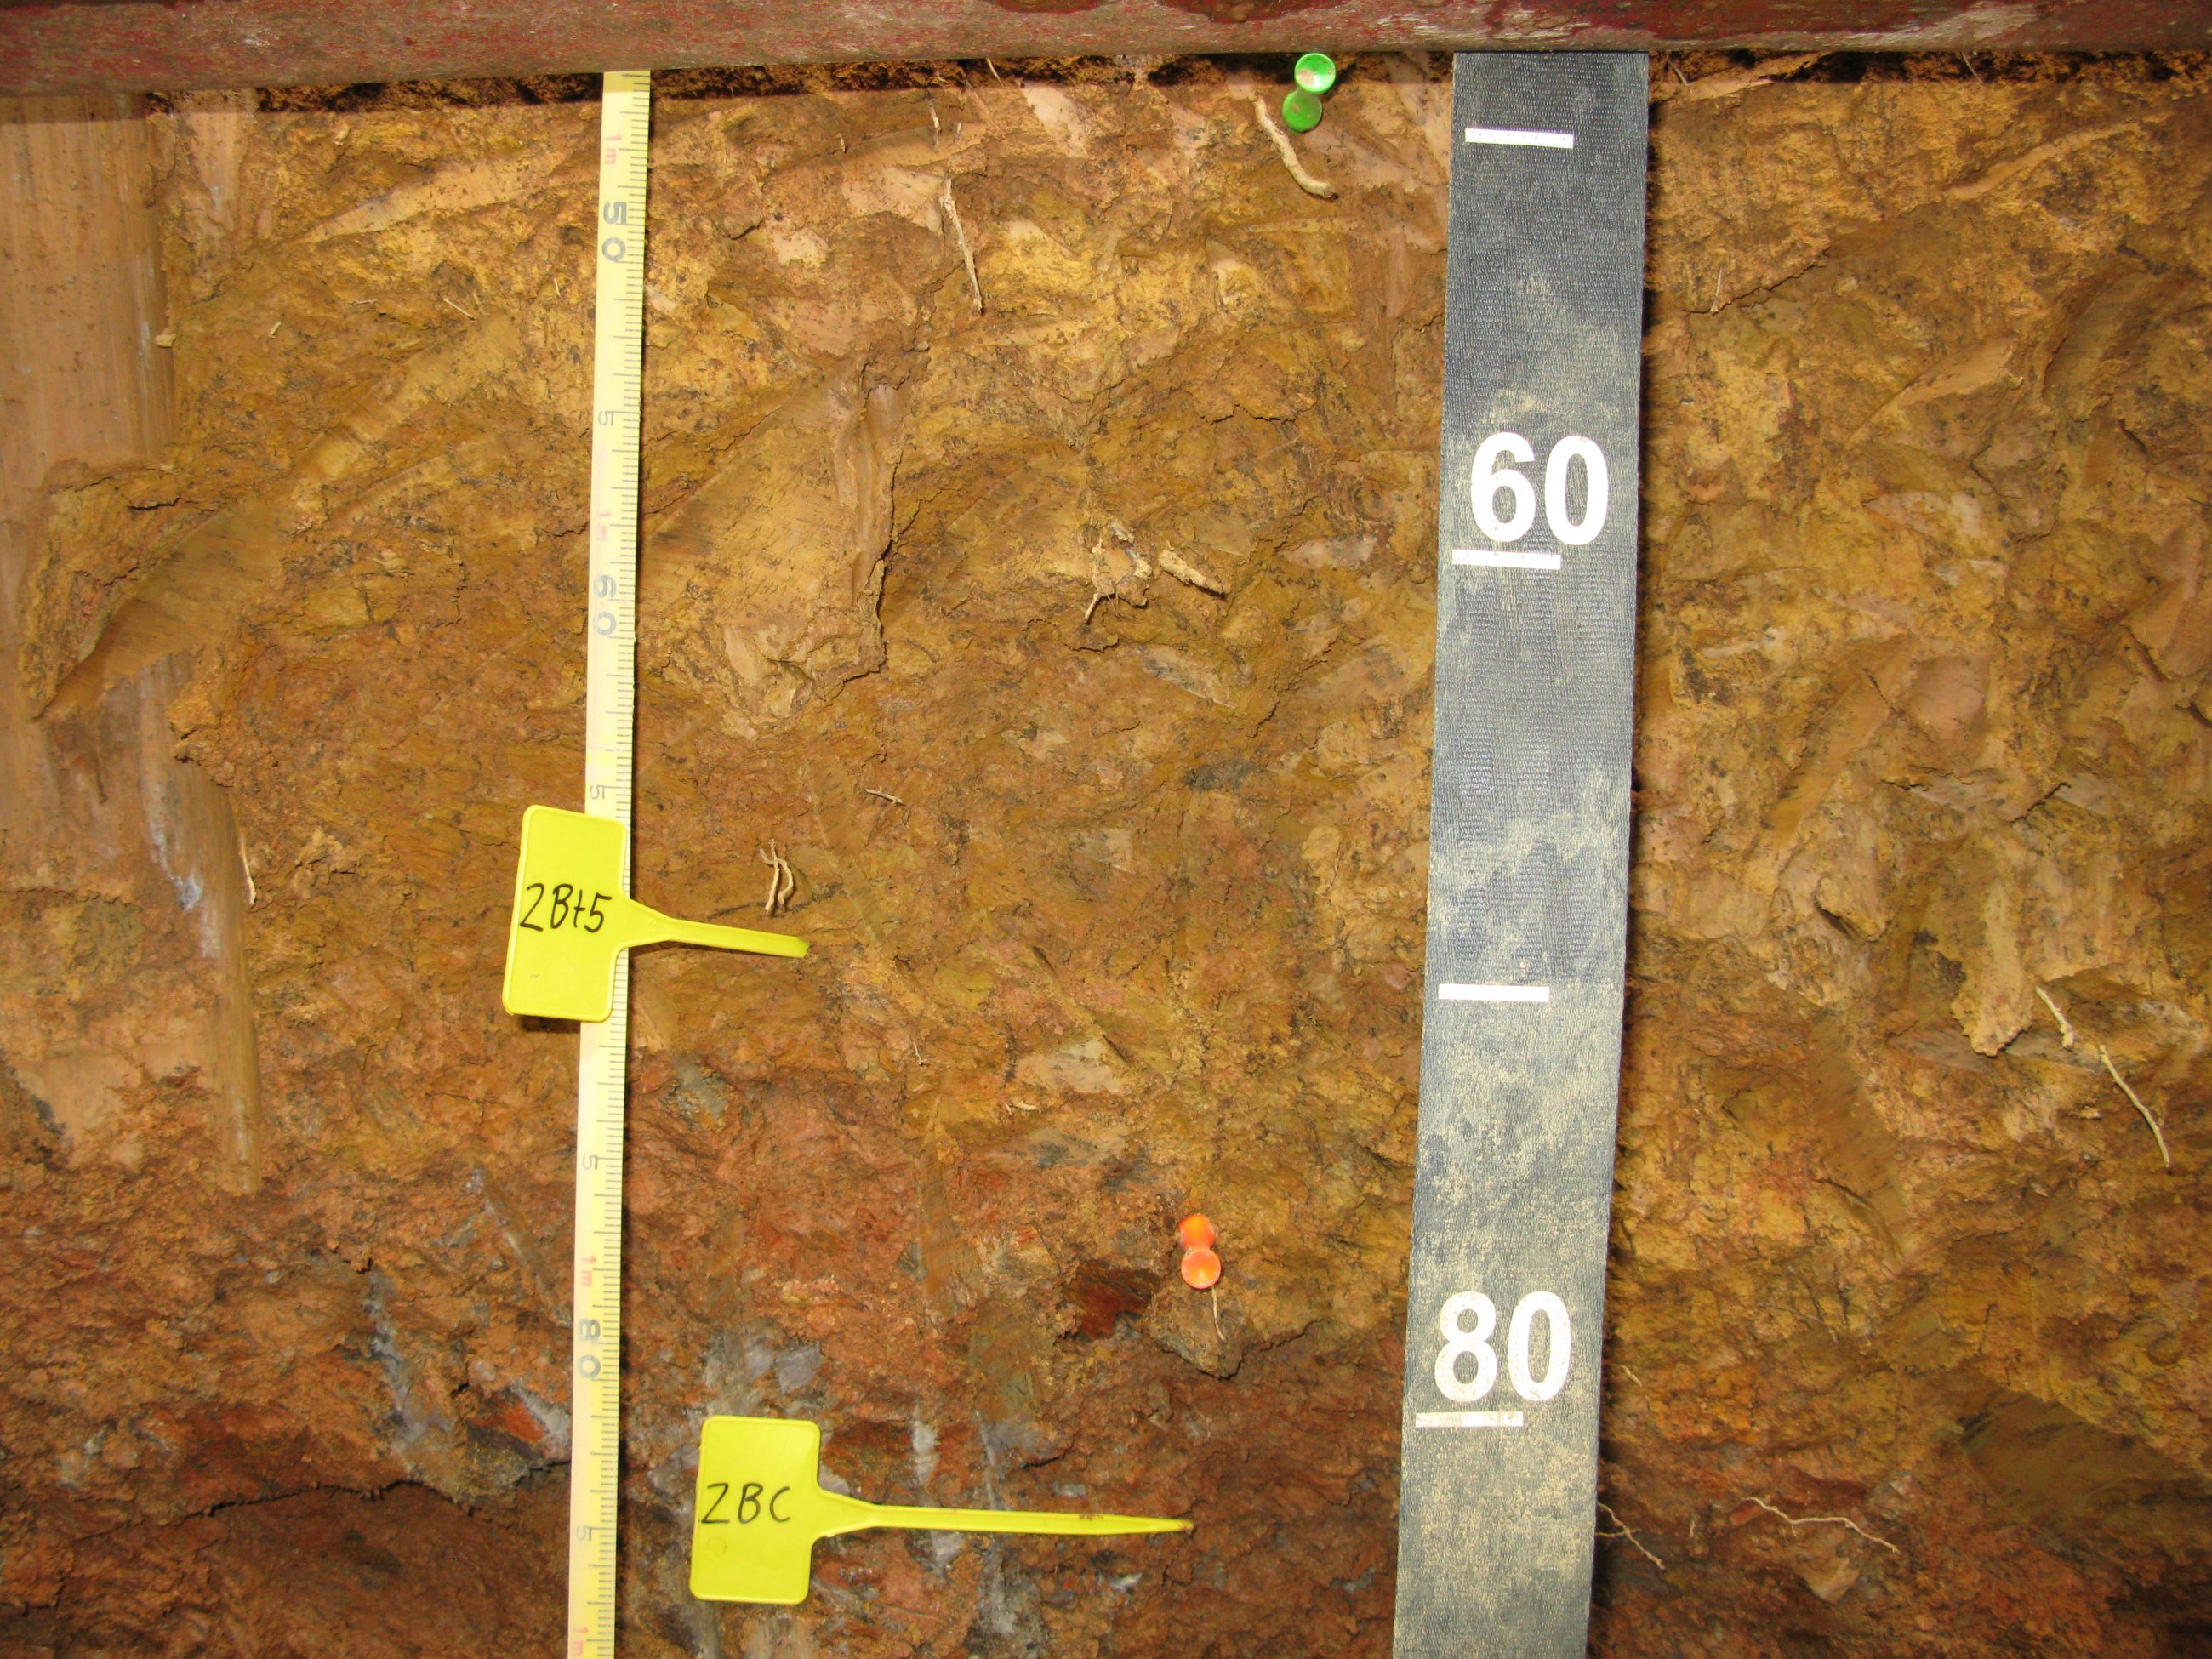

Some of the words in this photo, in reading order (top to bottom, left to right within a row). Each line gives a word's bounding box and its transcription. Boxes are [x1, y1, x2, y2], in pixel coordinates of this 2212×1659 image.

[601, 202, 627, 262] 50
[598, 410, 614, 425] 5
[1470, 431, 1610, 545] 60
[594, 575, 617, 636] 60
[589, 784, 606, 800] 5
[582, 1154, 598, 1170] 5
[578, 1319, 601, 1378] 80
[1434, 1291, 1571, 1402] 80
[576, 1525, 593, 1541] 5
